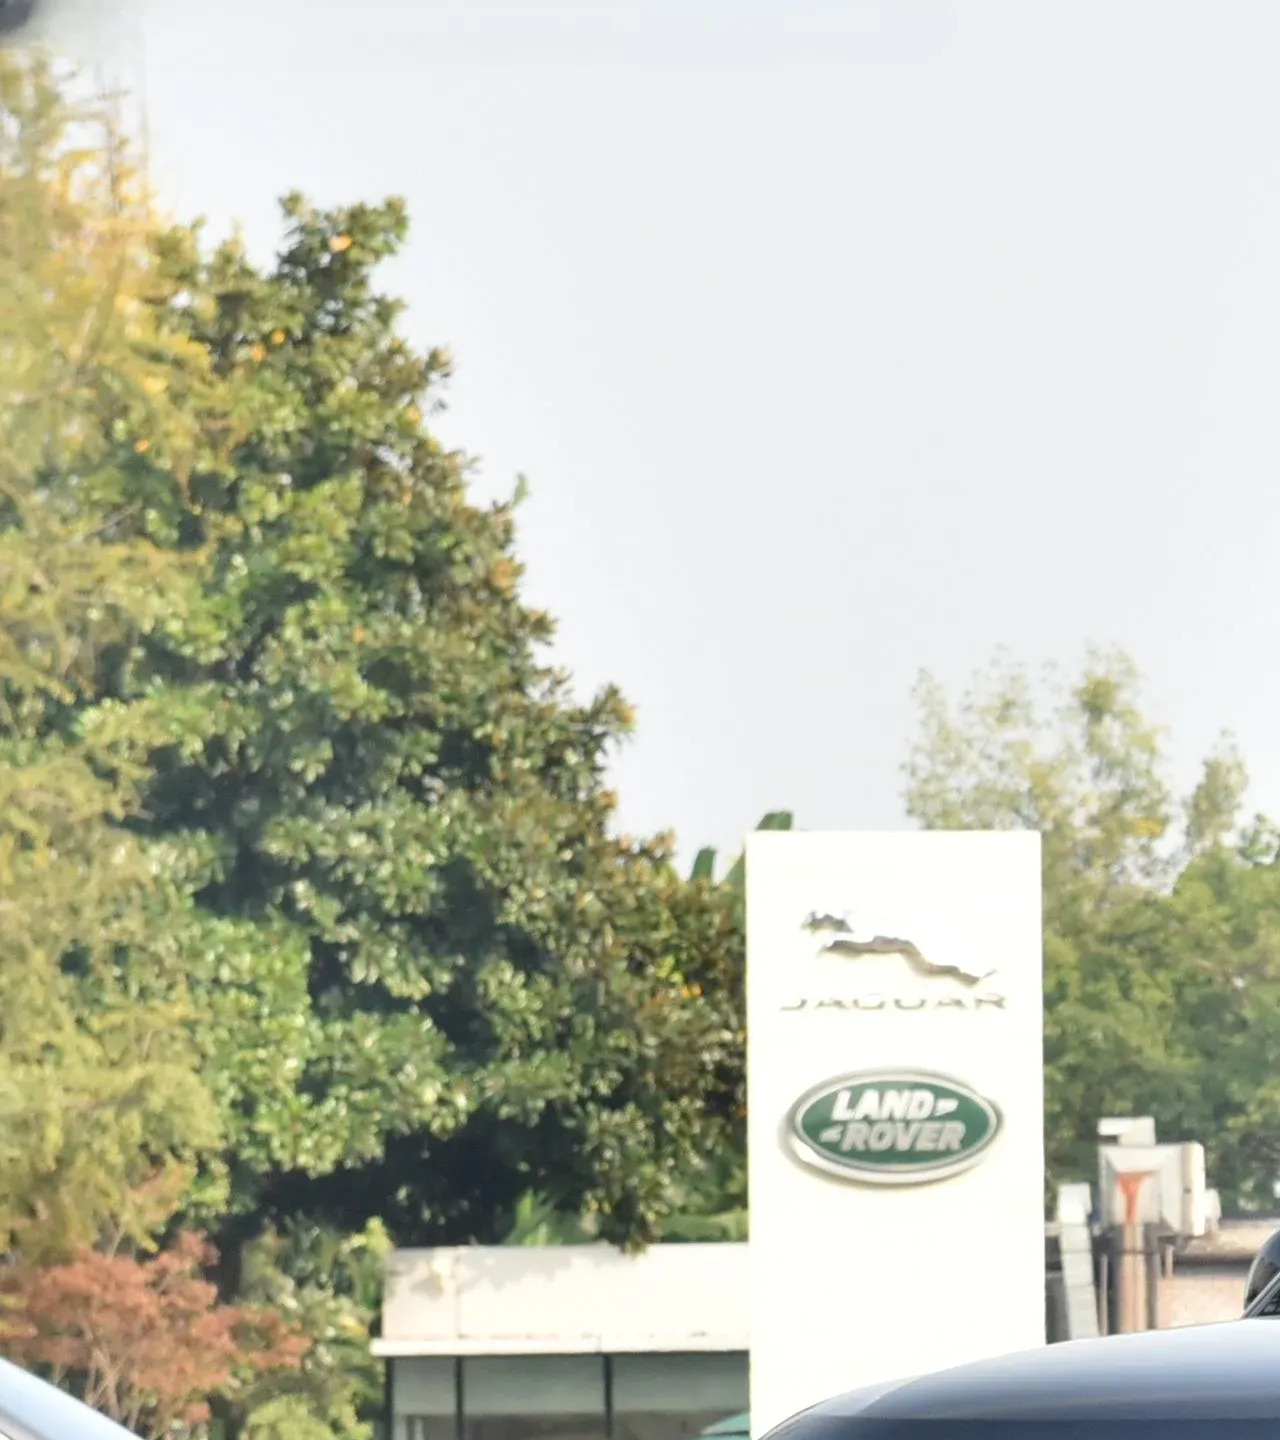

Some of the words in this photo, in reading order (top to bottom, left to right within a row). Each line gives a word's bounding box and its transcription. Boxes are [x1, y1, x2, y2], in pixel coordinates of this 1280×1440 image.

[780, 992, 1007, 1011] JAGUAR
[832, 1089, 935, 1121] LAND
[841, 1120, 967, 1152] ROVER
